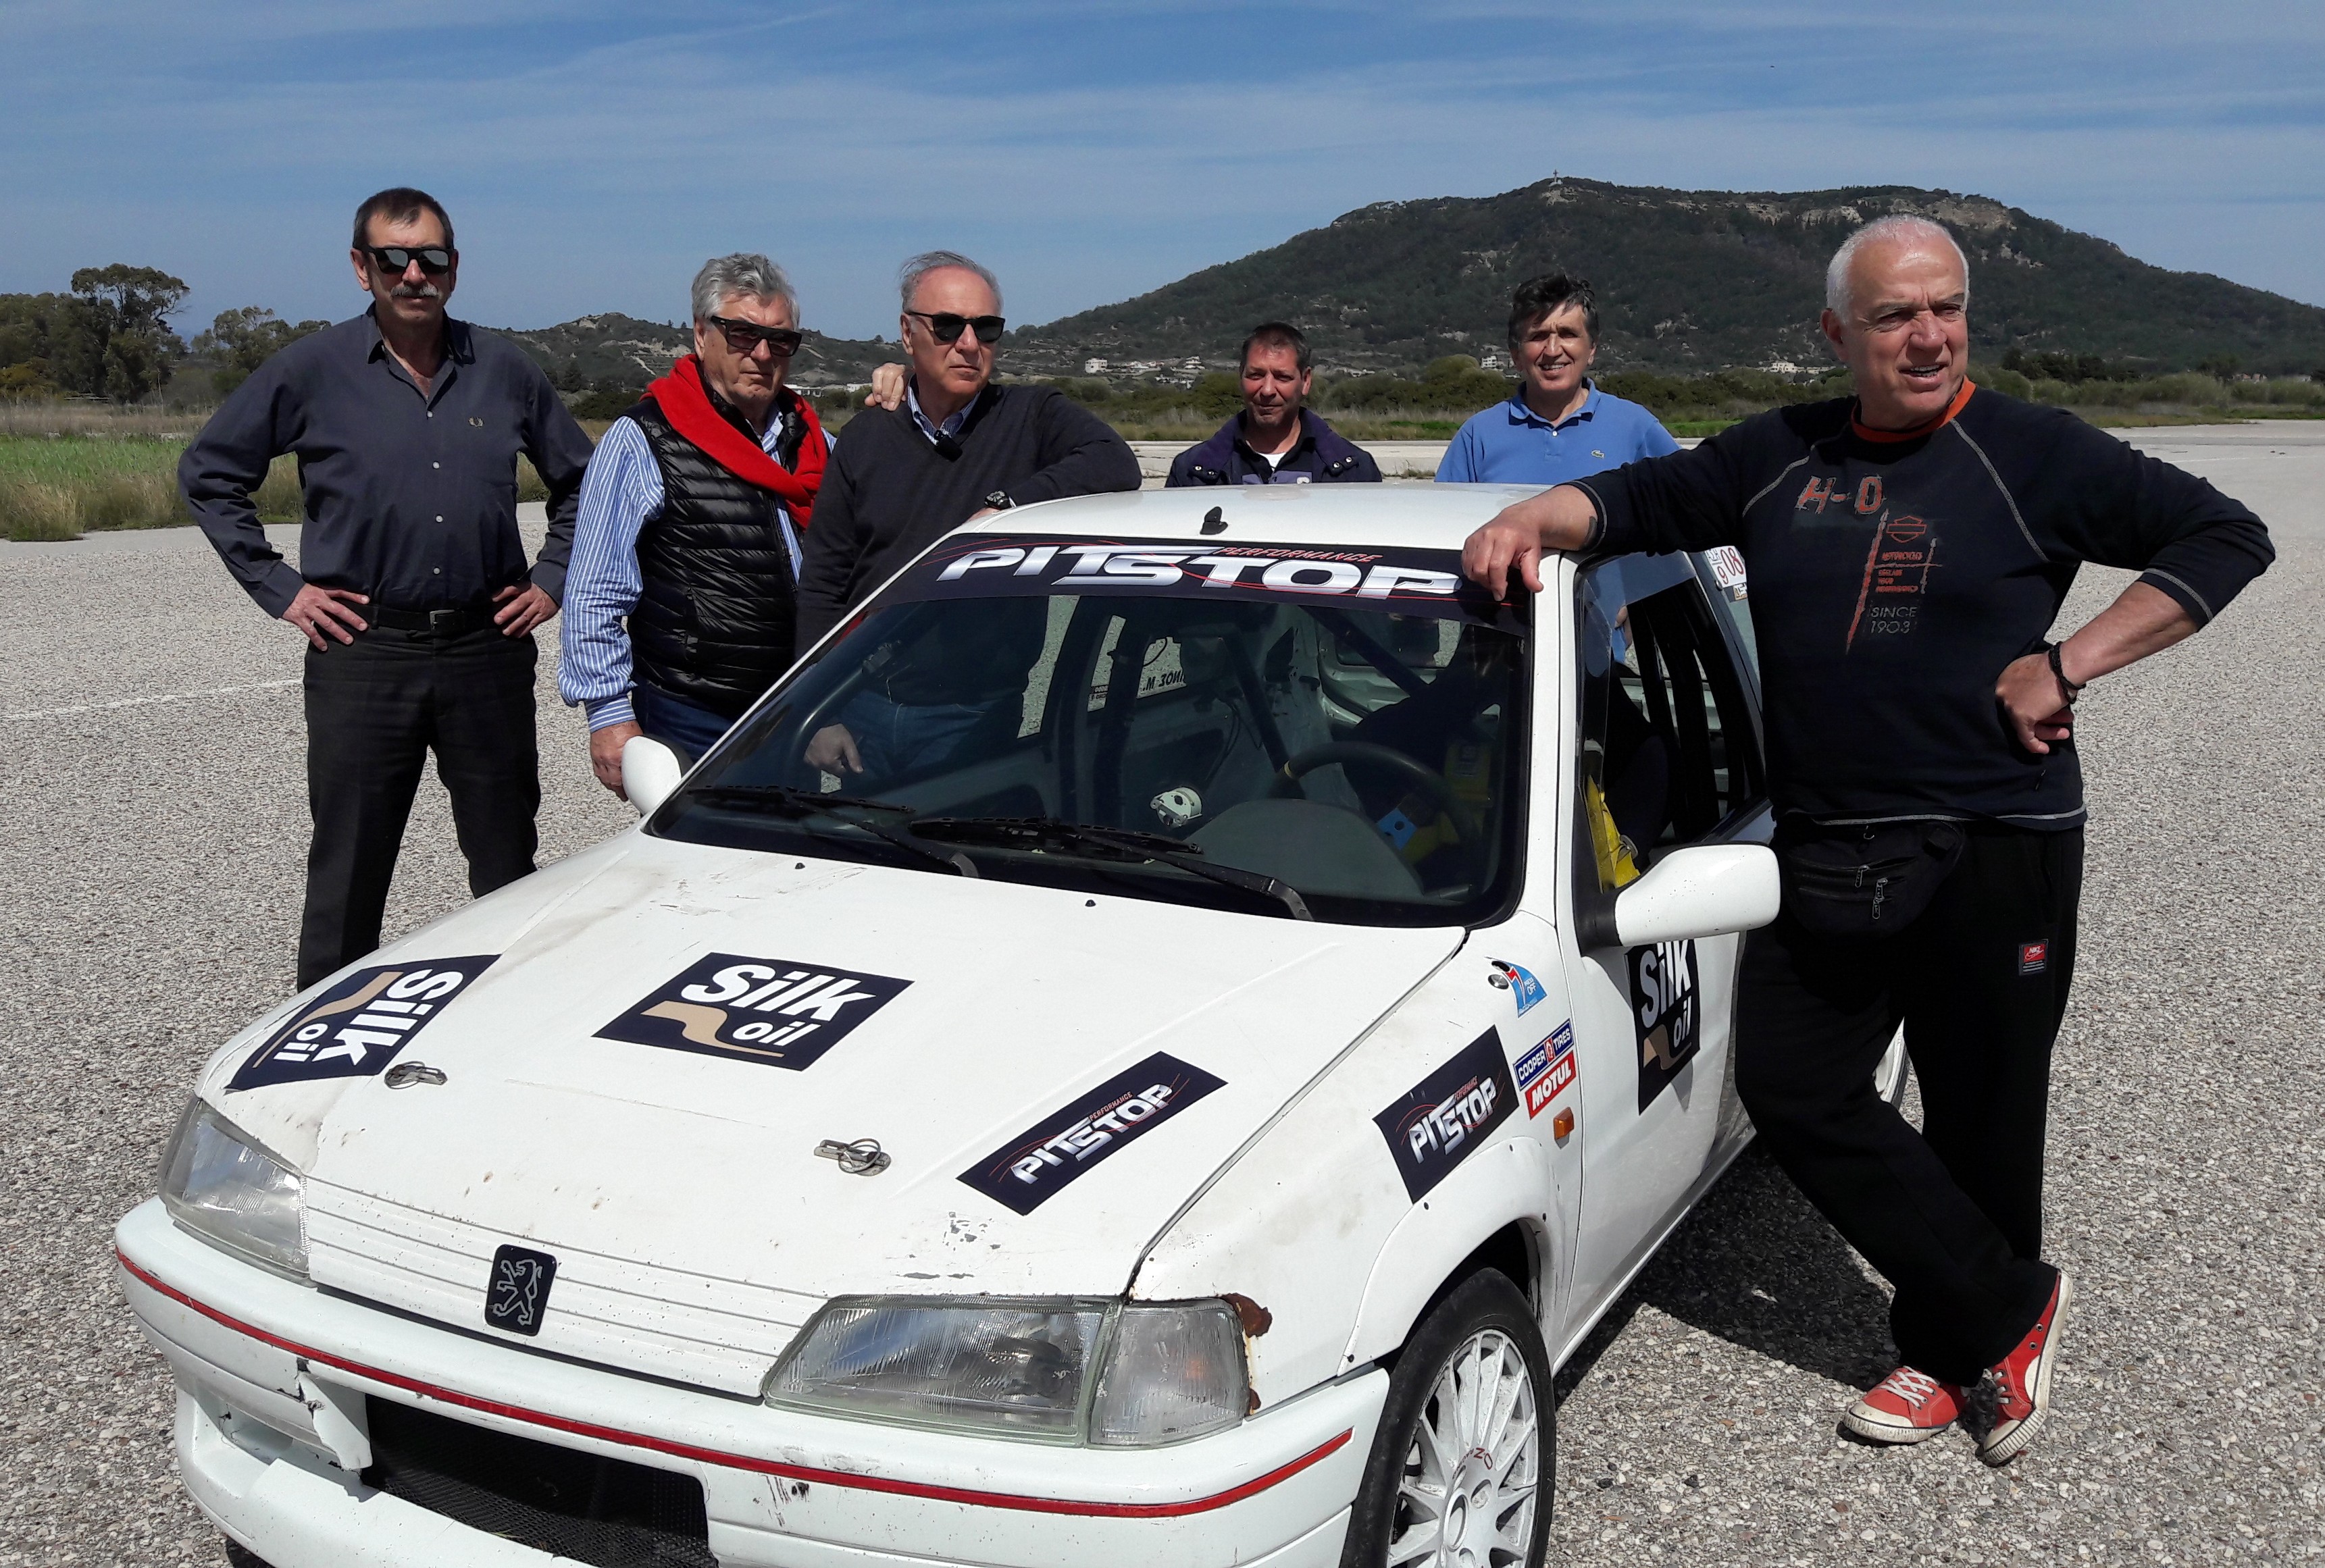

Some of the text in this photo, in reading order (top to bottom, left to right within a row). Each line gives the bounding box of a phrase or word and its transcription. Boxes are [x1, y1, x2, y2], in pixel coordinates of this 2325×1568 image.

[937, 546, 1463, 600] PITSTOP
[1213, 547, 1383, 563] PERFORMANCE
[1870, 606, 1918, 618] SINCE
[1870, 620, 1910, 634] 1903
[2029, 945, 2041, 954] NIKE
[680, 964, 877, 1022] Silk
[1640, 939, 1691, 1028] Silk
[311, 968, 464, 1066] Silk
[732, 1021, 822, 1047] oil
[1673, 995, 1692, 1048] oil
[273, 1023, 328, 1062] oil
[1517, 1027, 1571, 1082] COOPER TIRES
[1089, 1090, 1133, 1122] PERFORMANCE
[1531, 1065, 1573, 1112] MOTUL
[1011, 1083, 1173, 1184] PITSTOP
[1409, 1076, 1497, 1164] PITSTOP
